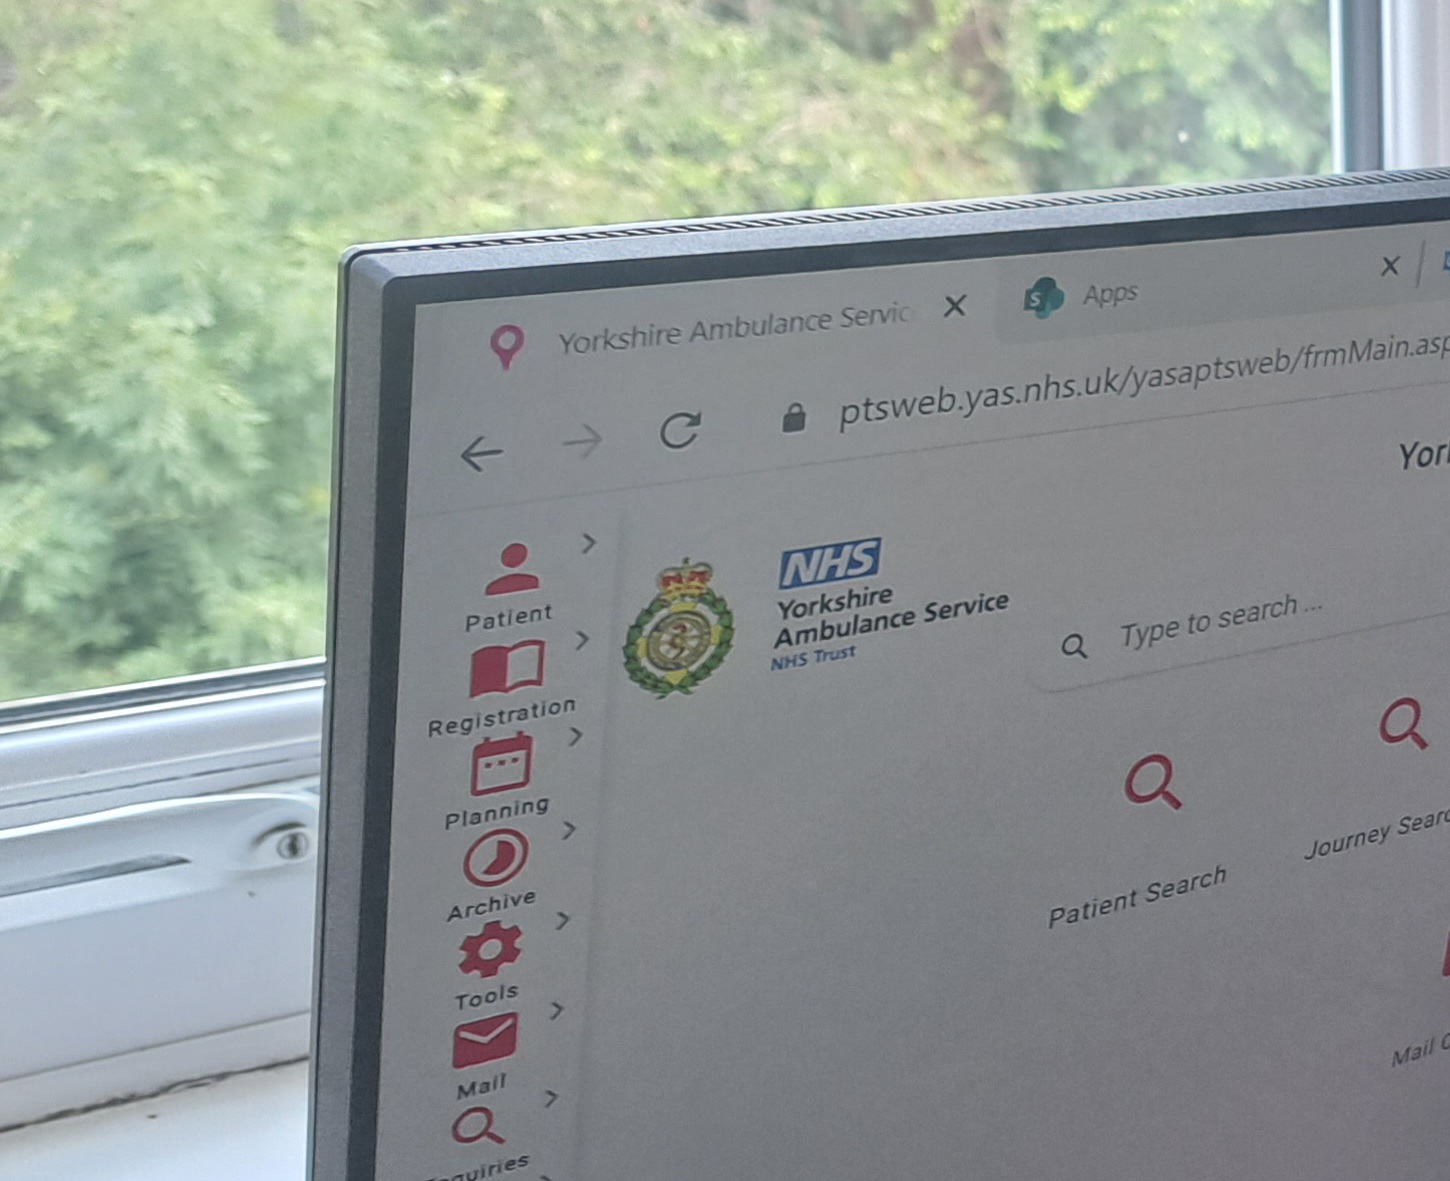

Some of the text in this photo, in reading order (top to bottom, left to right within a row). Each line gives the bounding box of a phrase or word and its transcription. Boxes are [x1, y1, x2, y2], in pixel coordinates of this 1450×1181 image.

[1082, 281, 1139, 308] Apps
[558, 323, 681, 356] Yorkshire
[689, 309, 831, 344] Ambulance
[784, 541, 878, 588] NHS
[464, 605, 552, 633] Patient
[773, 590, 1009, 650] Ambulance Service
[778, 585, 894, 621] Yorkshire
[1120, 594, 1298, 649] Type to search
[771, 644, 856, 672] NHS Trust
[428, 698, 577, 739] Registration
[445, 798, 549, 830] Planning
[1304, 823, 1391, 861] Journey
[447, 890, 537, 922] Archive
[1048, 865, 1227, 929] Patient Search
[454, 984, 519, 1011] Tools
[1391, 1036, 1435, 1068] Mail
[457, 1072, 507, 1100] Mail
